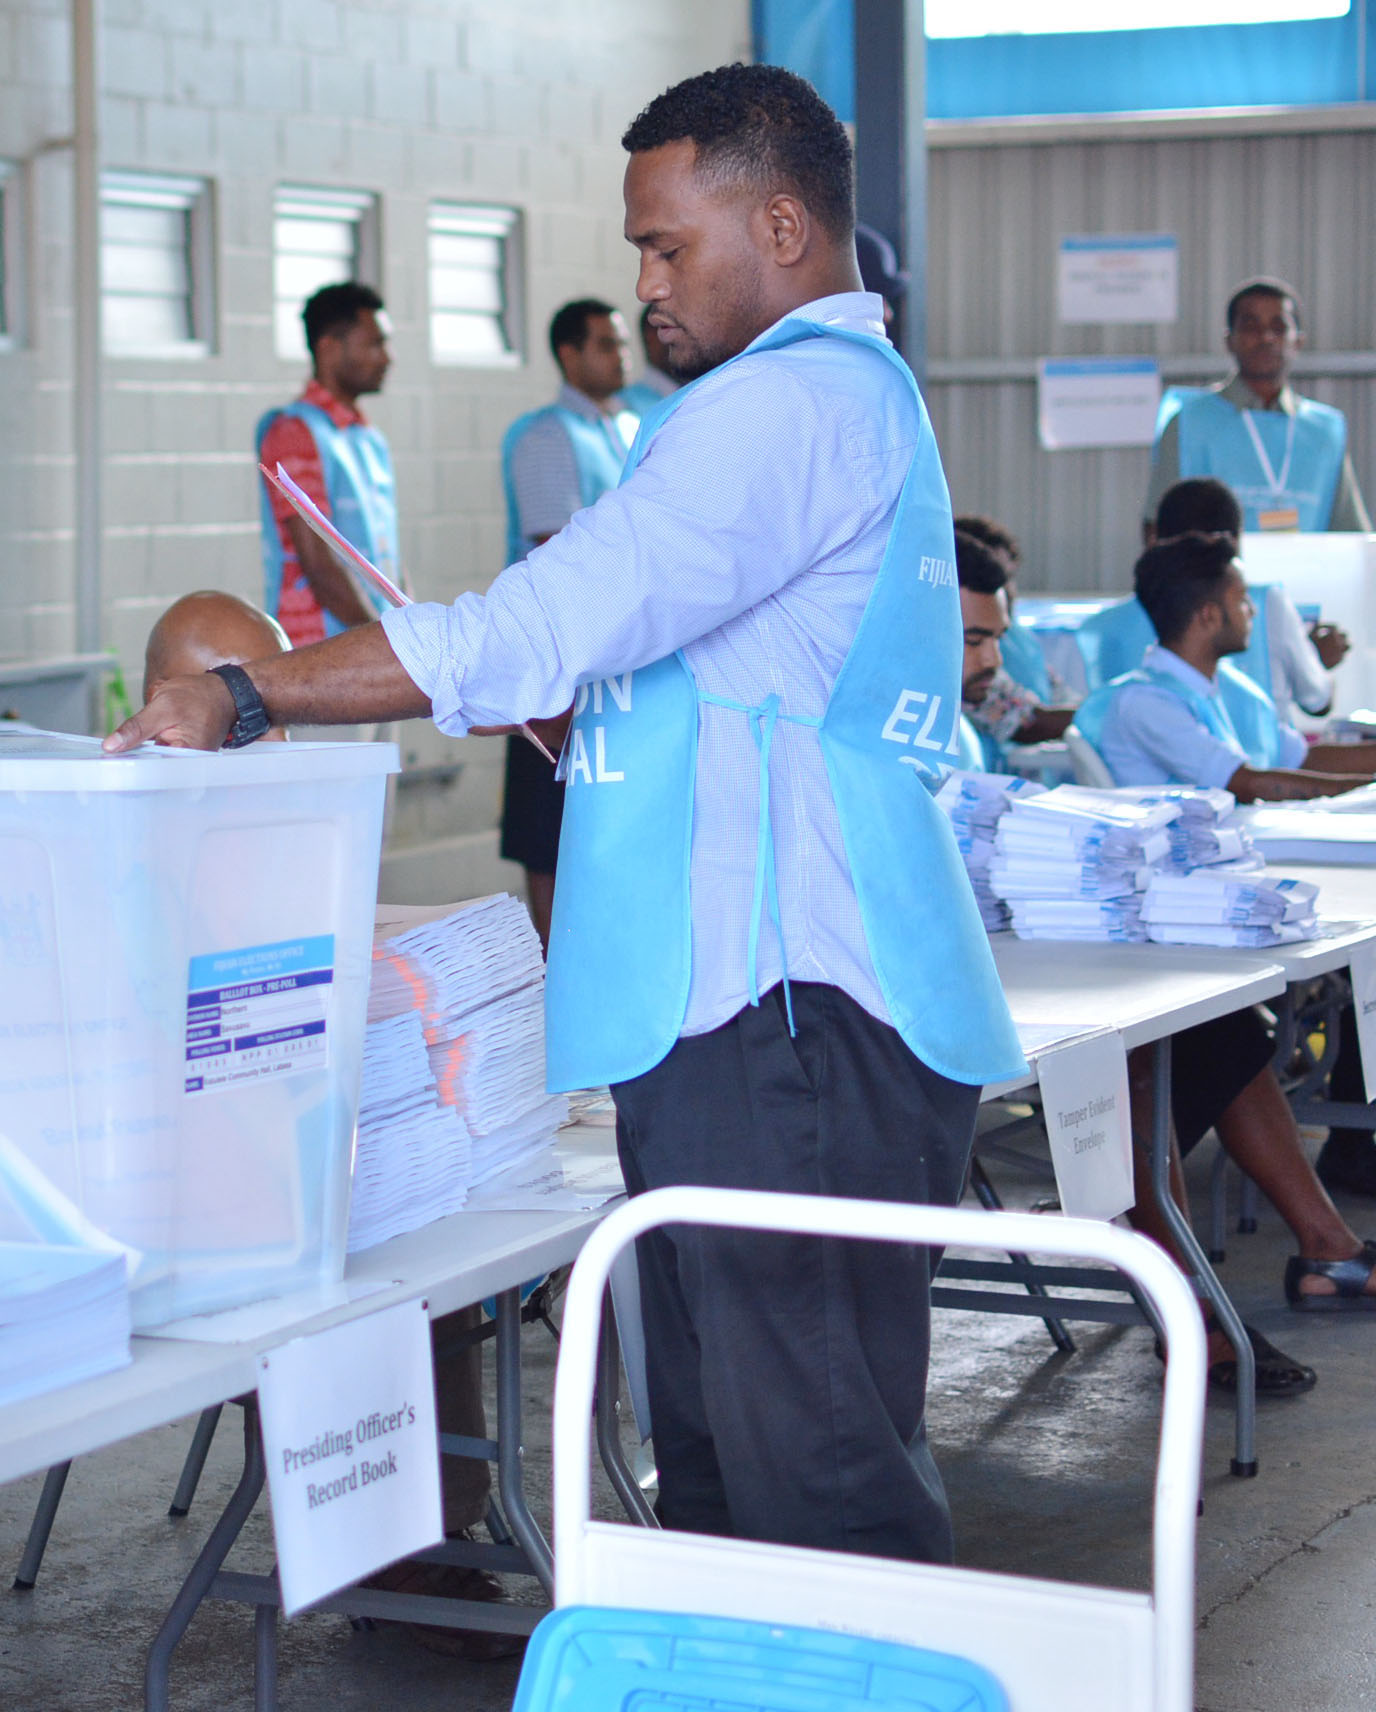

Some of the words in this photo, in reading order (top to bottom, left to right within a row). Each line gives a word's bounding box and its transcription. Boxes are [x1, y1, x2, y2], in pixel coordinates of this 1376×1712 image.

[1057, 1107, 1088, 1129] Tamper
[1088, 1094, 1115, 1118] Evident
[1073, 1129, 1106, 1154] Envelope
[283, 1430, 353, 1475] Presiding
[356, 1400, 416, 1444] Officer's
[306, 1464, 358, 1509] Record
[360, 1450, 397, 1487] Book
